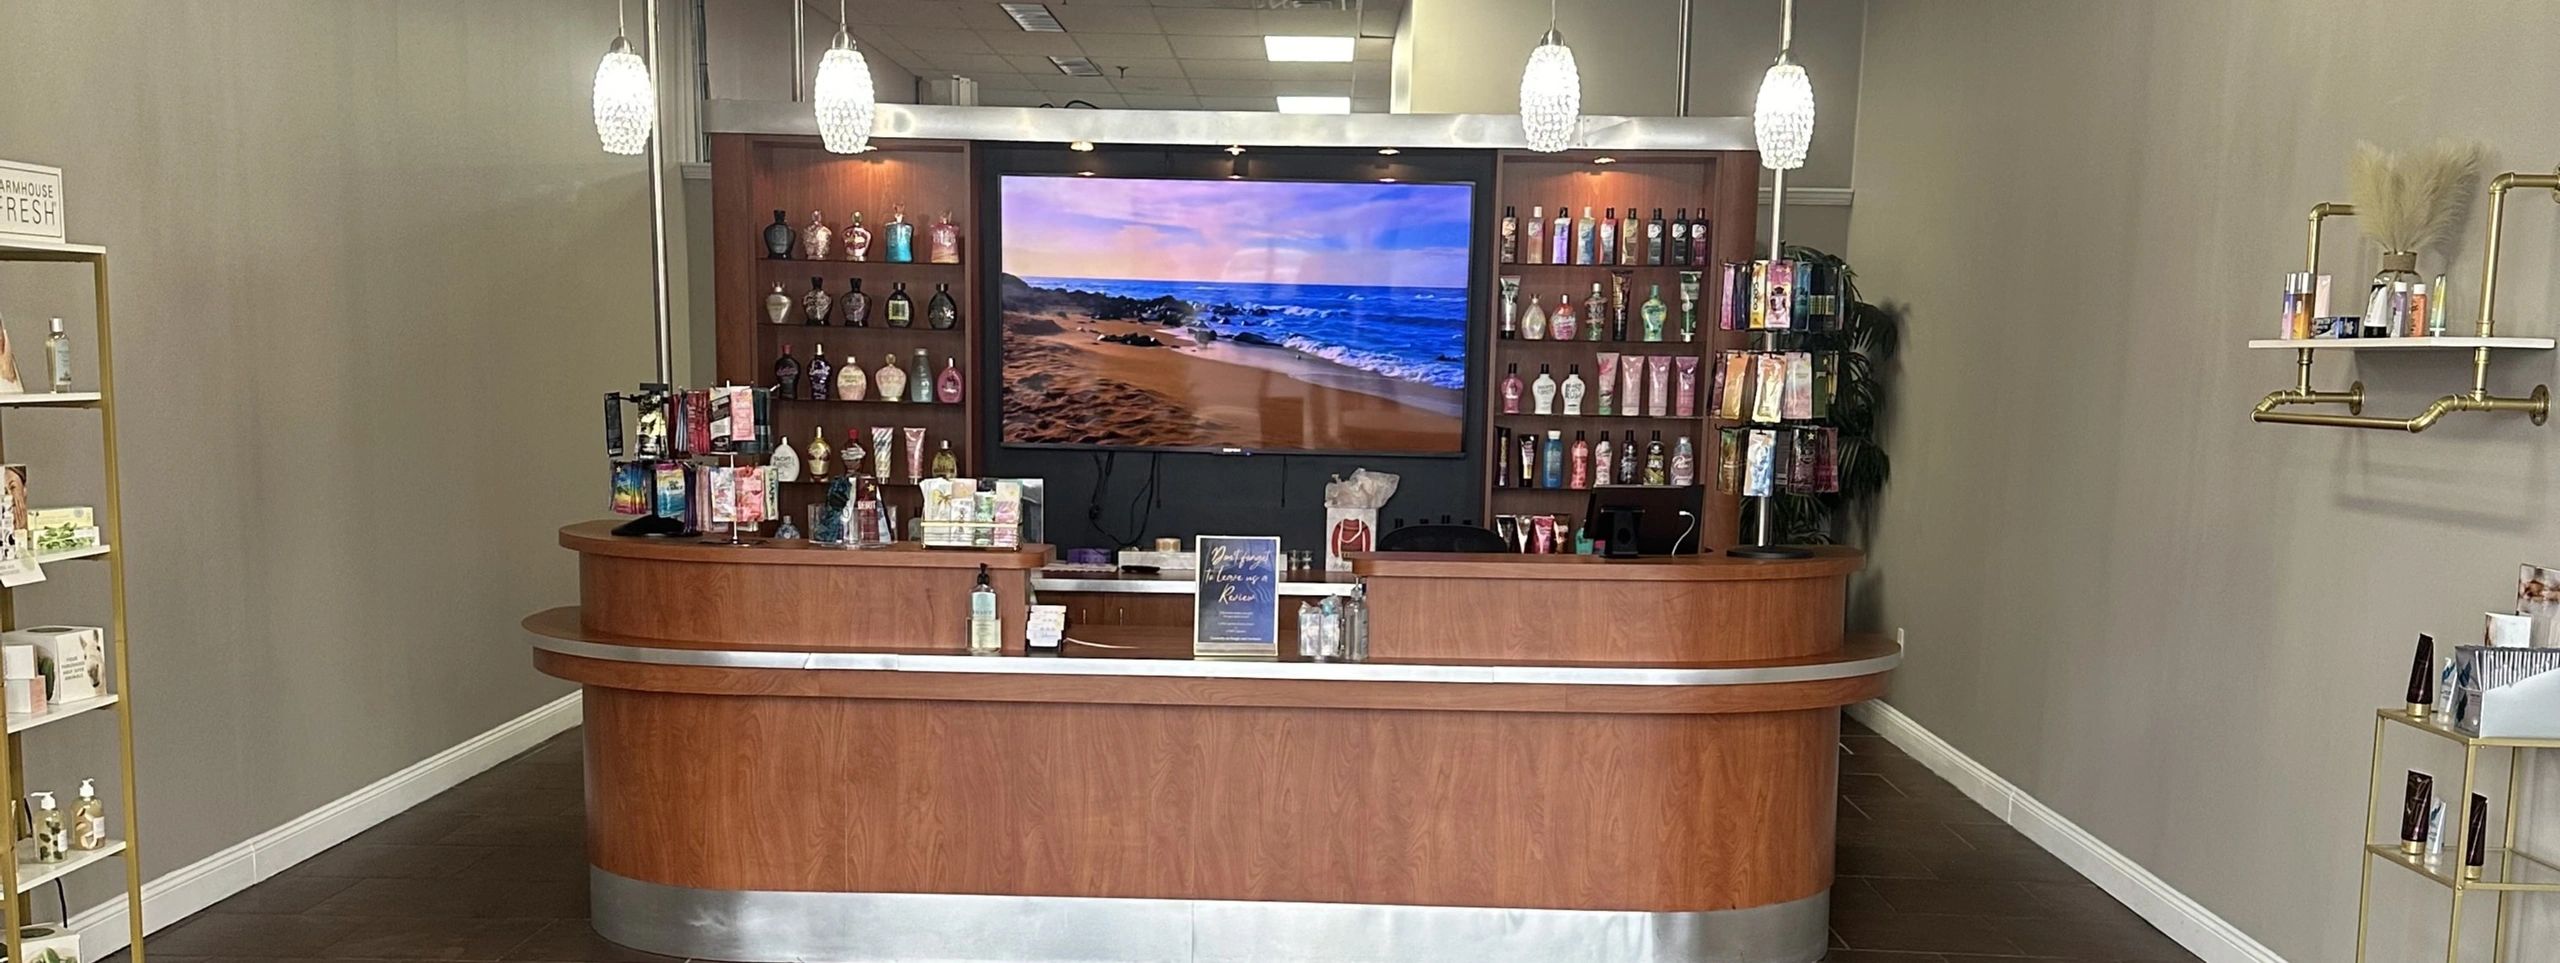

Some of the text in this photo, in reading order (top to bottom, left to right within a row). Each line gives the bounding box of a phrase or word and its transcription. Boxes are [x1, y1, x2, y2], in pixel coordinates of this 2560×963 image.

[1238, 549, 1270, 570] forget
[1205, 568, 1213, 584] to
[1246, 575, 1259, 585] us
[1218, 584, 1254, 604] Review
